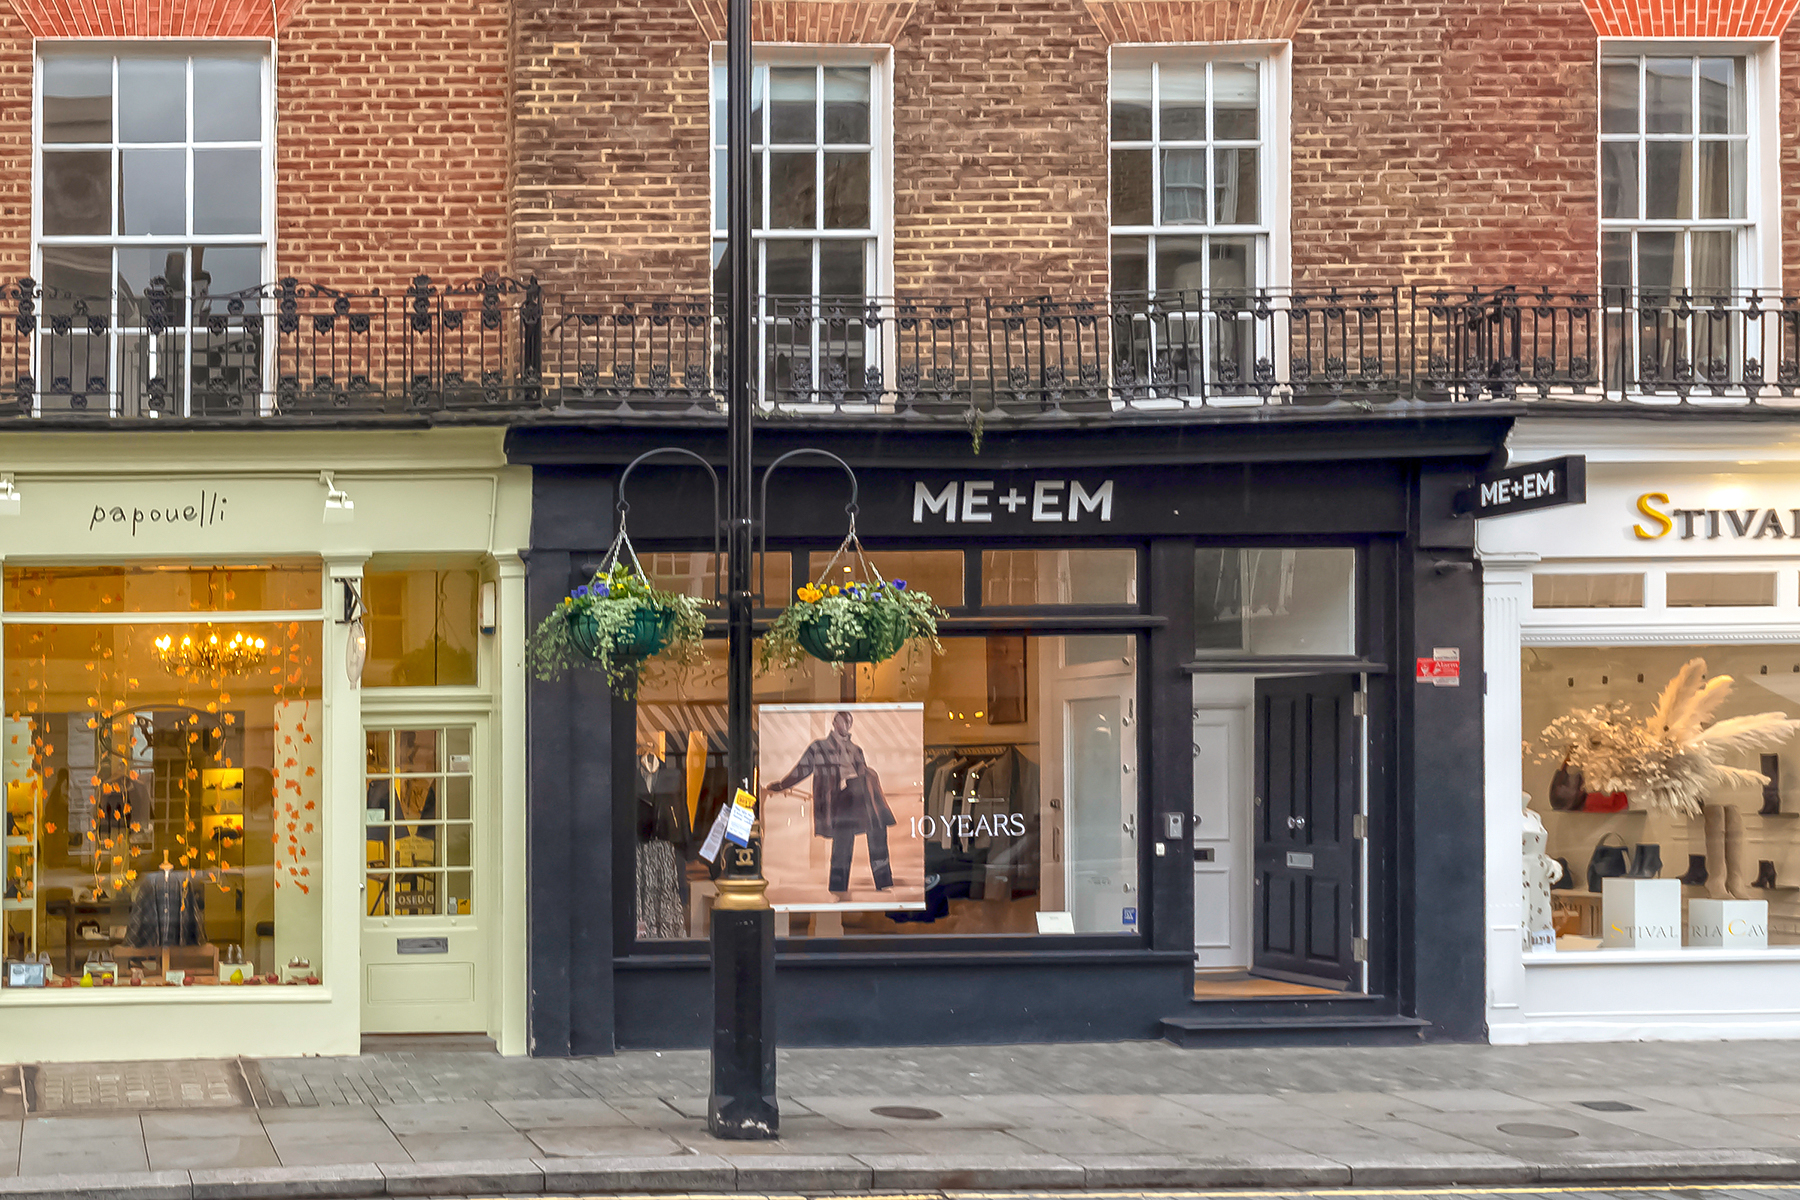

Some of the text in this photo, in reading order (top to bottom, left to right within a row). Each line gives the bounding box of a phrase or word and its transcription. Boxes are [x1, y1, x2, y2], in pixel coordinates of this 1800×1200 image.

[913, 480, 1114, 523] ME+EM
[1480, 469, 1556, 508] ME+EM
[89, 490, 227, 537] papouelli
[910, 812, 1026, 838] 10 YEARS
[1609, 918, 1723, 940] STIVALRIA
